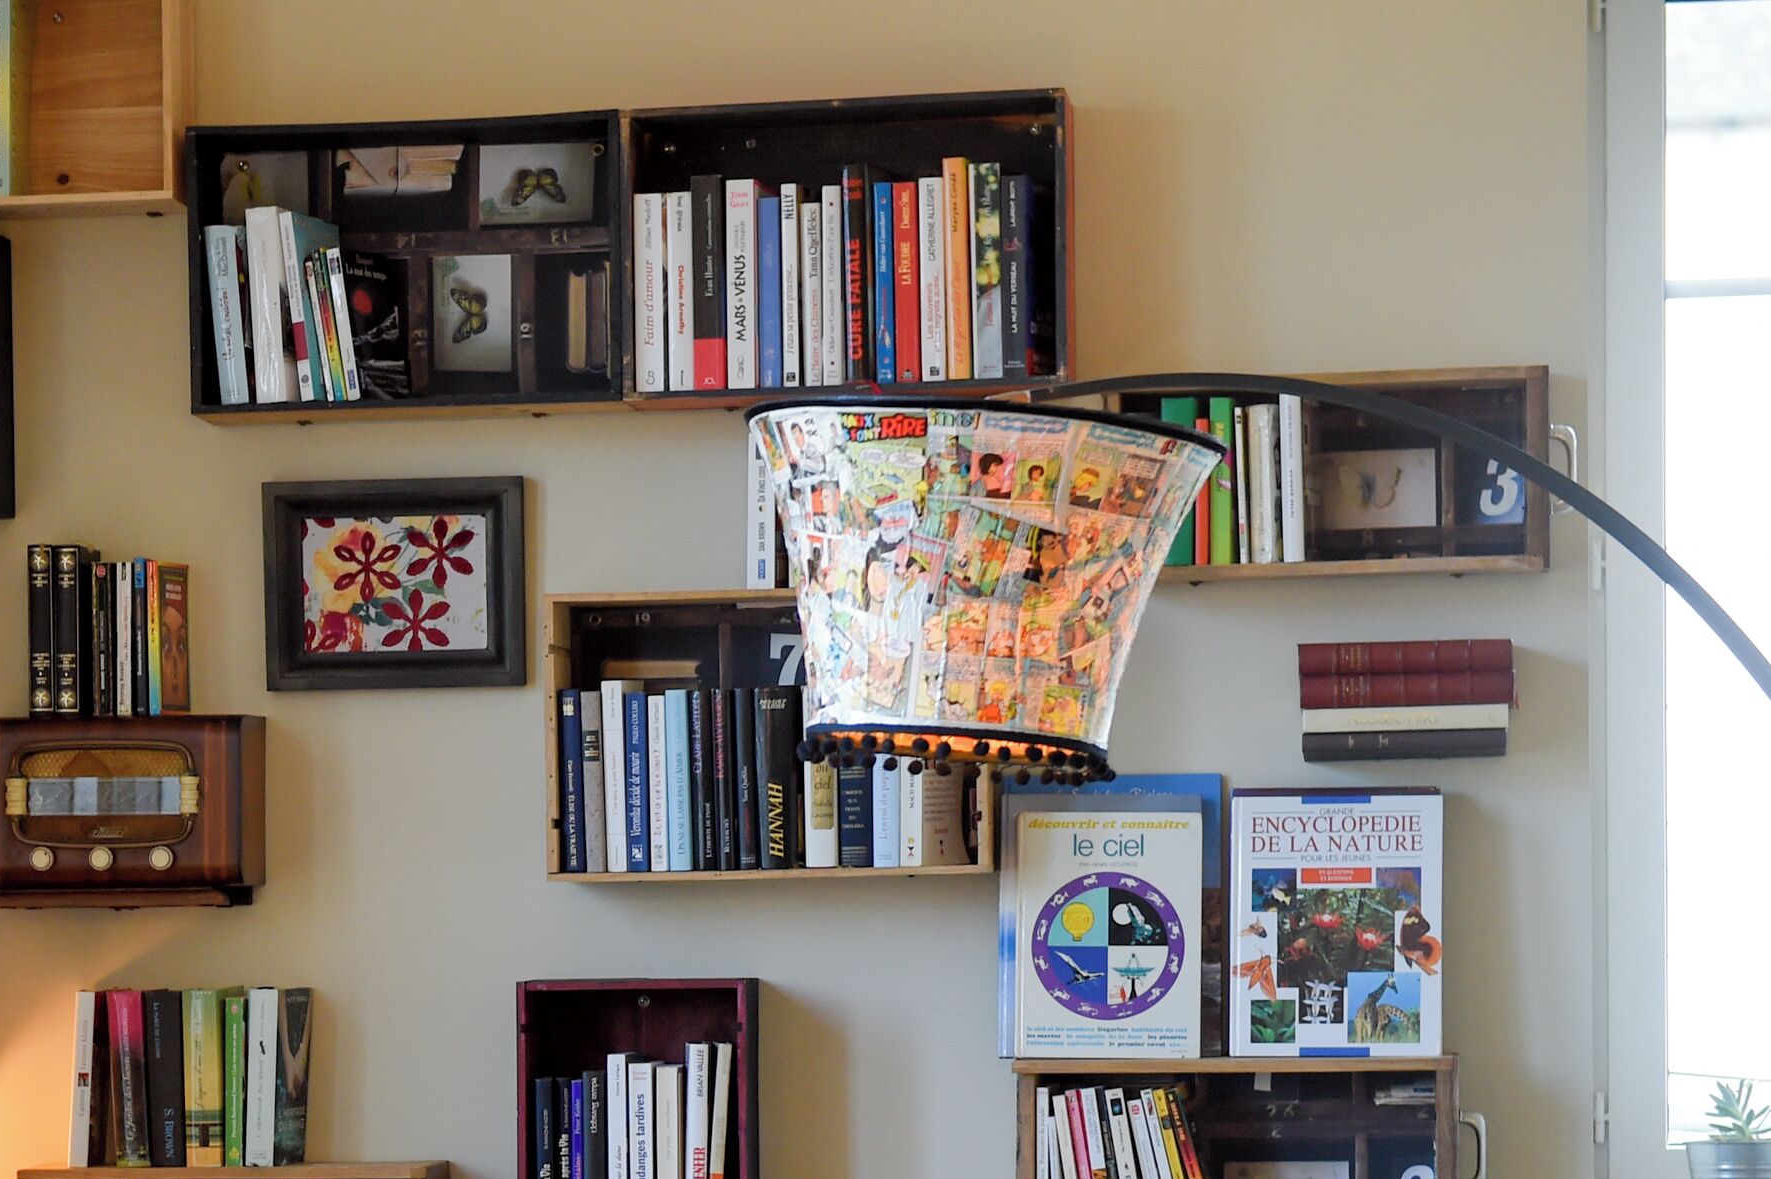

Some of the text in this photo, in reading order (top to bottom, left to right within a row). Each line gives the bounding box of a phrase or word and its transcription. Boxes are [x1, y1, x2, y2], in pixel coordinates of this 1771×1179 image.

[898, 241, 911, 285] LA FOUDRE
[926, 222, 936, 263] CATHERINE
[643, 259, 655, 346] Faim d'amour
[730, 254, 747, 342] MARS VÉNUS
[847, 239, 863, 361] CURE FATALE
[1010, 260, 1019, 333] LA NUIT DU VERSEAU
[1479, 458, 1521, 518] 3
[768, 783, 785, 858] HANNAH
[1028, 817, 1189, 830] découvrir et connaître
[1251, 814, 1422, 835] ENCYCLOPEDIE
[1319, 807, 1355, 816] GRANDE
[1072, 832, 1145, 857] le ciel
[1251, 833, 1424, 854] DE LA NATURE
[1300, 853, 1372, 863] POUR LES JEUNES
[695, 1048, 705, 1098] BRIAN VALLÉE
[634, 1093, 645, 1137] tardives
[164, 1119, 175, 1158] BROWN
[559, 1156, 570, 1178] après
[691, 1146, 706, 1179] ENFER
